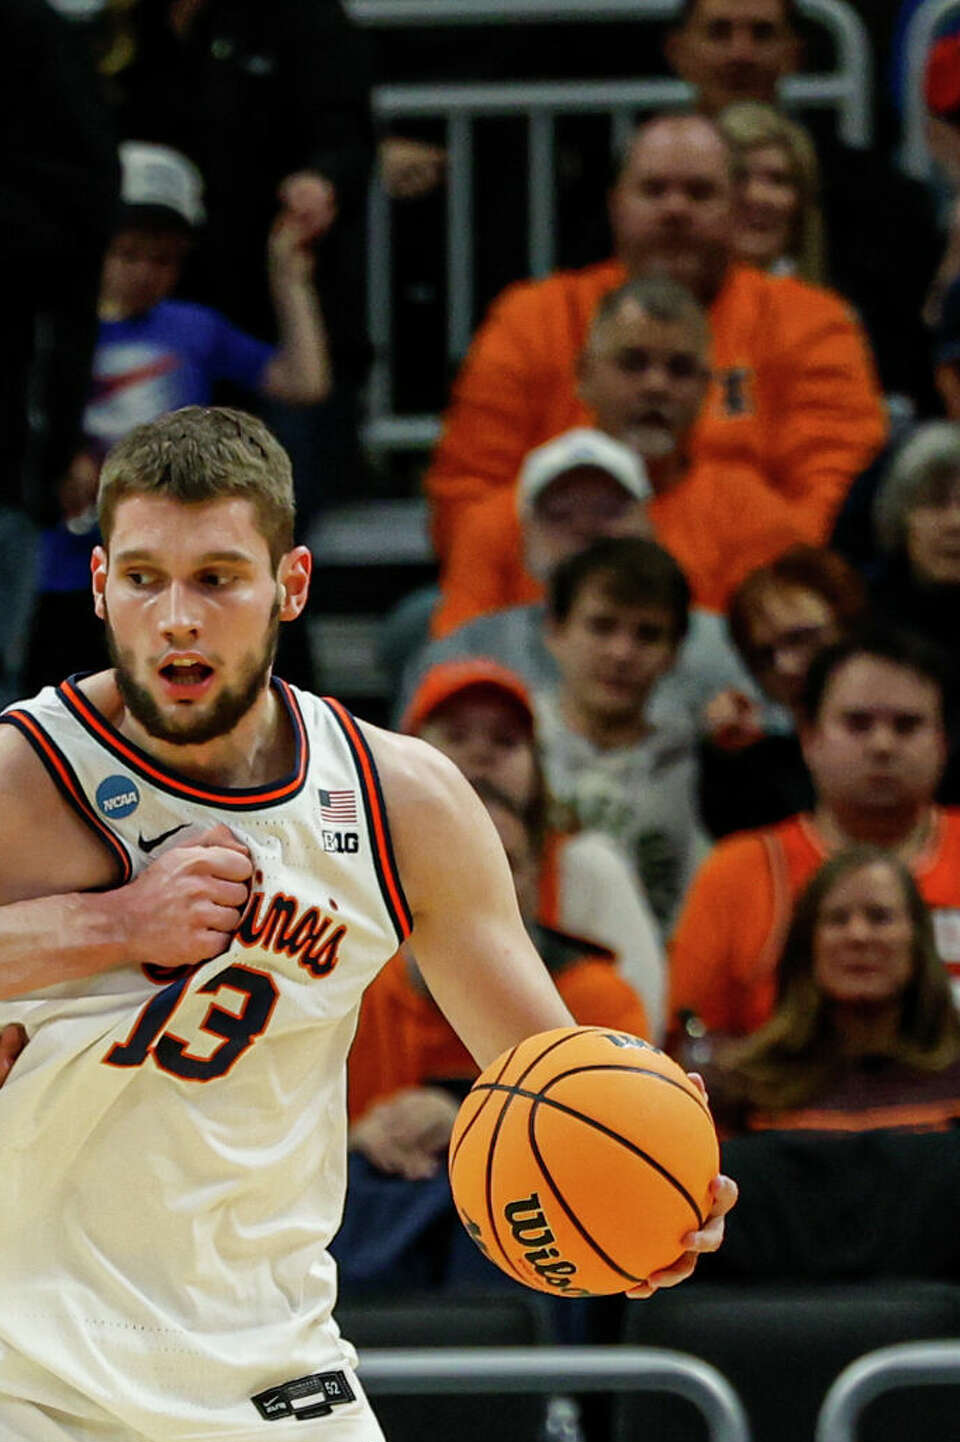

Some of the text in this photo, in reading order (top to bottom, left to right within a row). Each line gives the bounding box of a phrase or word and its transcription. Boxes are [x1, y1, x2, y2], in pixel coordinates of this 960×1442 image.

[103, 791, 138, 812] NCAA
[234, 869, 348, 979] inois
[101, 962, 281, 1083] 13
[324, 1381, 341, 1396] 52
